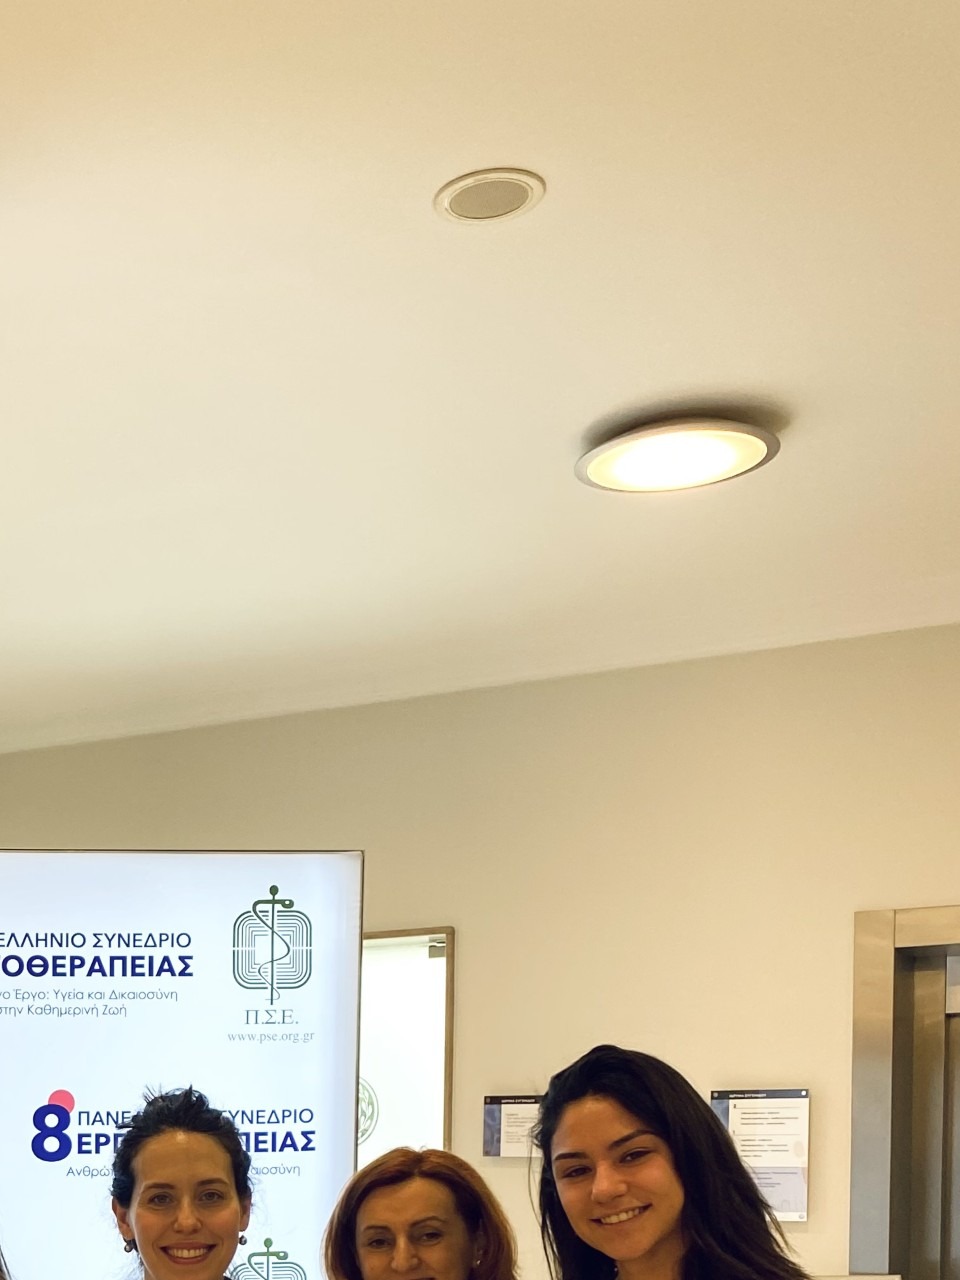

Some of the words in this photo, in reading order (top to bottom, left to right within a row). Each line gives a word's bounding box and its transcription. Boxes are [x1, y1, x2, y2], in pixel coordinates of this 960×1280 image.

[92, 932, 192, 948] ΣΥΝΕΔΡΙΟ
[13, 988, 50, 1002] Έργο:
[53, 988, 84, 1002] Υγεία
[88, 990, 106, 1000] και
[109, 988, 178, 1002] Δικαιοσύνη
[27, 1004, 99, 1018] Καθημερινή
[102, 1004, 127, 1018] Ζωή
[244, 1009, 299, 1025] Π.Σ.Ε.
[227, 1032, 315, 1044] www.pse.org.gr
[222, 1108, 314, 1125] ΥΝΕΔΡΙΟ
[31, 1103, 73, 1162] 8
[250, 1163, 301, 1177] αιοσύνη
